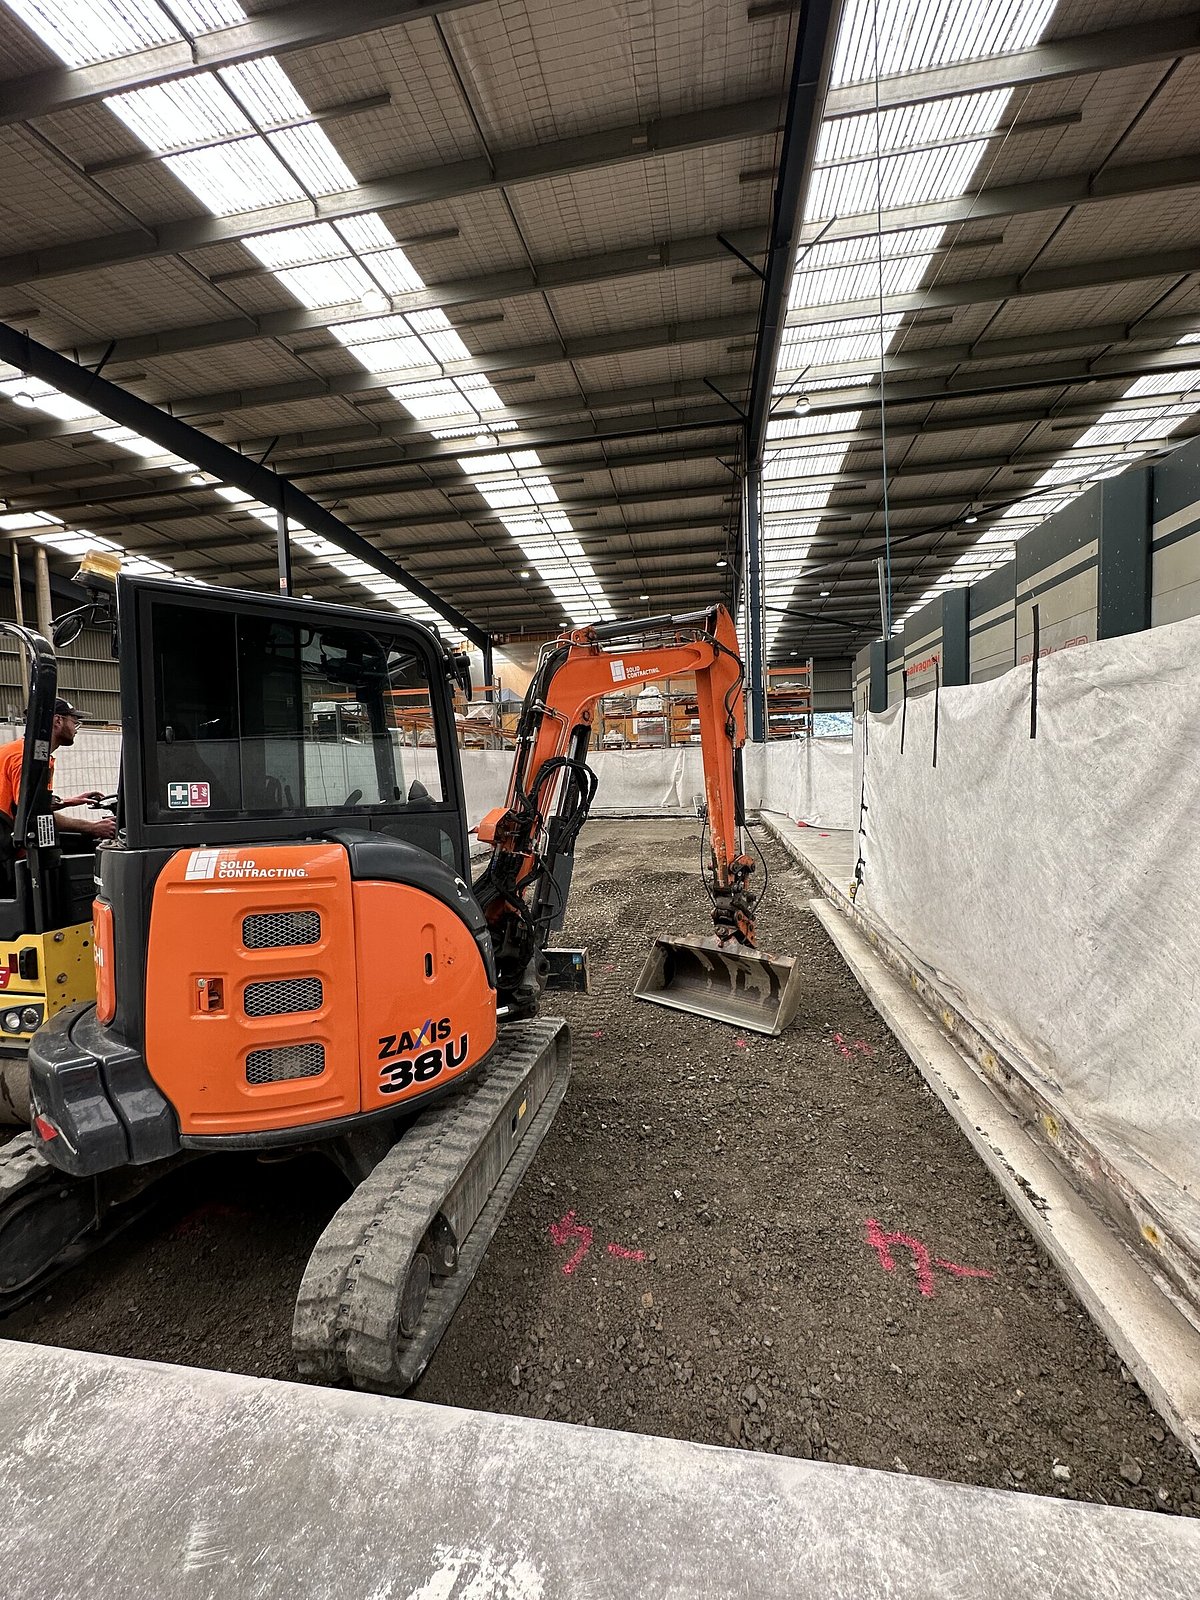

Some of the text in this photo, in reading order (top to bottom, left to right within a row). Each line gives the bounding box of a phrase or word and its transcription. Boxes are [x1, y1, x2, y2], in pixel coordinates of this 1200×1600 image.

[218, 868, 309, 878] CONTRACTING.
[220, 860, 255, 869] SOLID
[378, 1017, 452, 1060] ZAXIS
[378, 1033, 469, 1095] 38U
